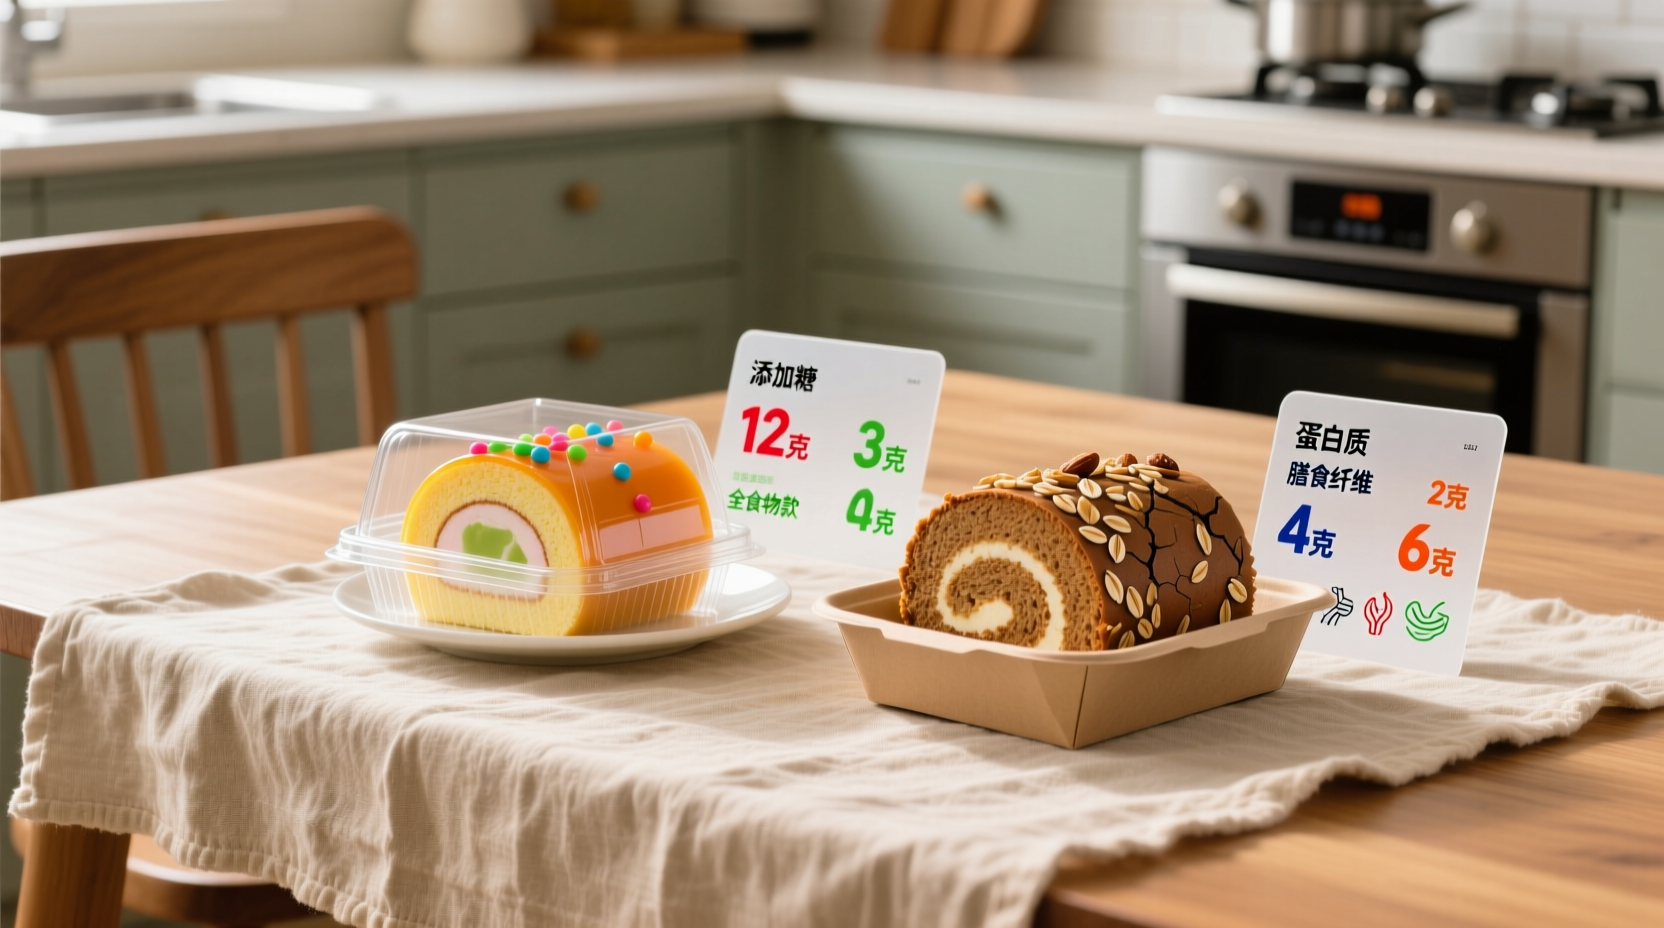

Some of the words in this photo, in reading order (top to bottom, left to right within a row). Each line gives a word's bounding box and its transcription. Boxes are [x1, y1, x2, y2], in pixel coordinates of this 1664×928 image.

[750, 360, 818, 392] 添加糖
[742, 406, 810, 460] 12克
[853, 420, 907, 473] 3克
[1296, 421, 1370, 456] 蛋白质
[1286, 461, 1373, 494] 膳食纤维
[1427, 480, 1469, 510] 2克
[727, 488, 799, 519] 全食物款
[846, 488, 896, 535] 4克
[1277, 504, 1336, 558] 4克
[1398, 523, 1456, 577] 6克
